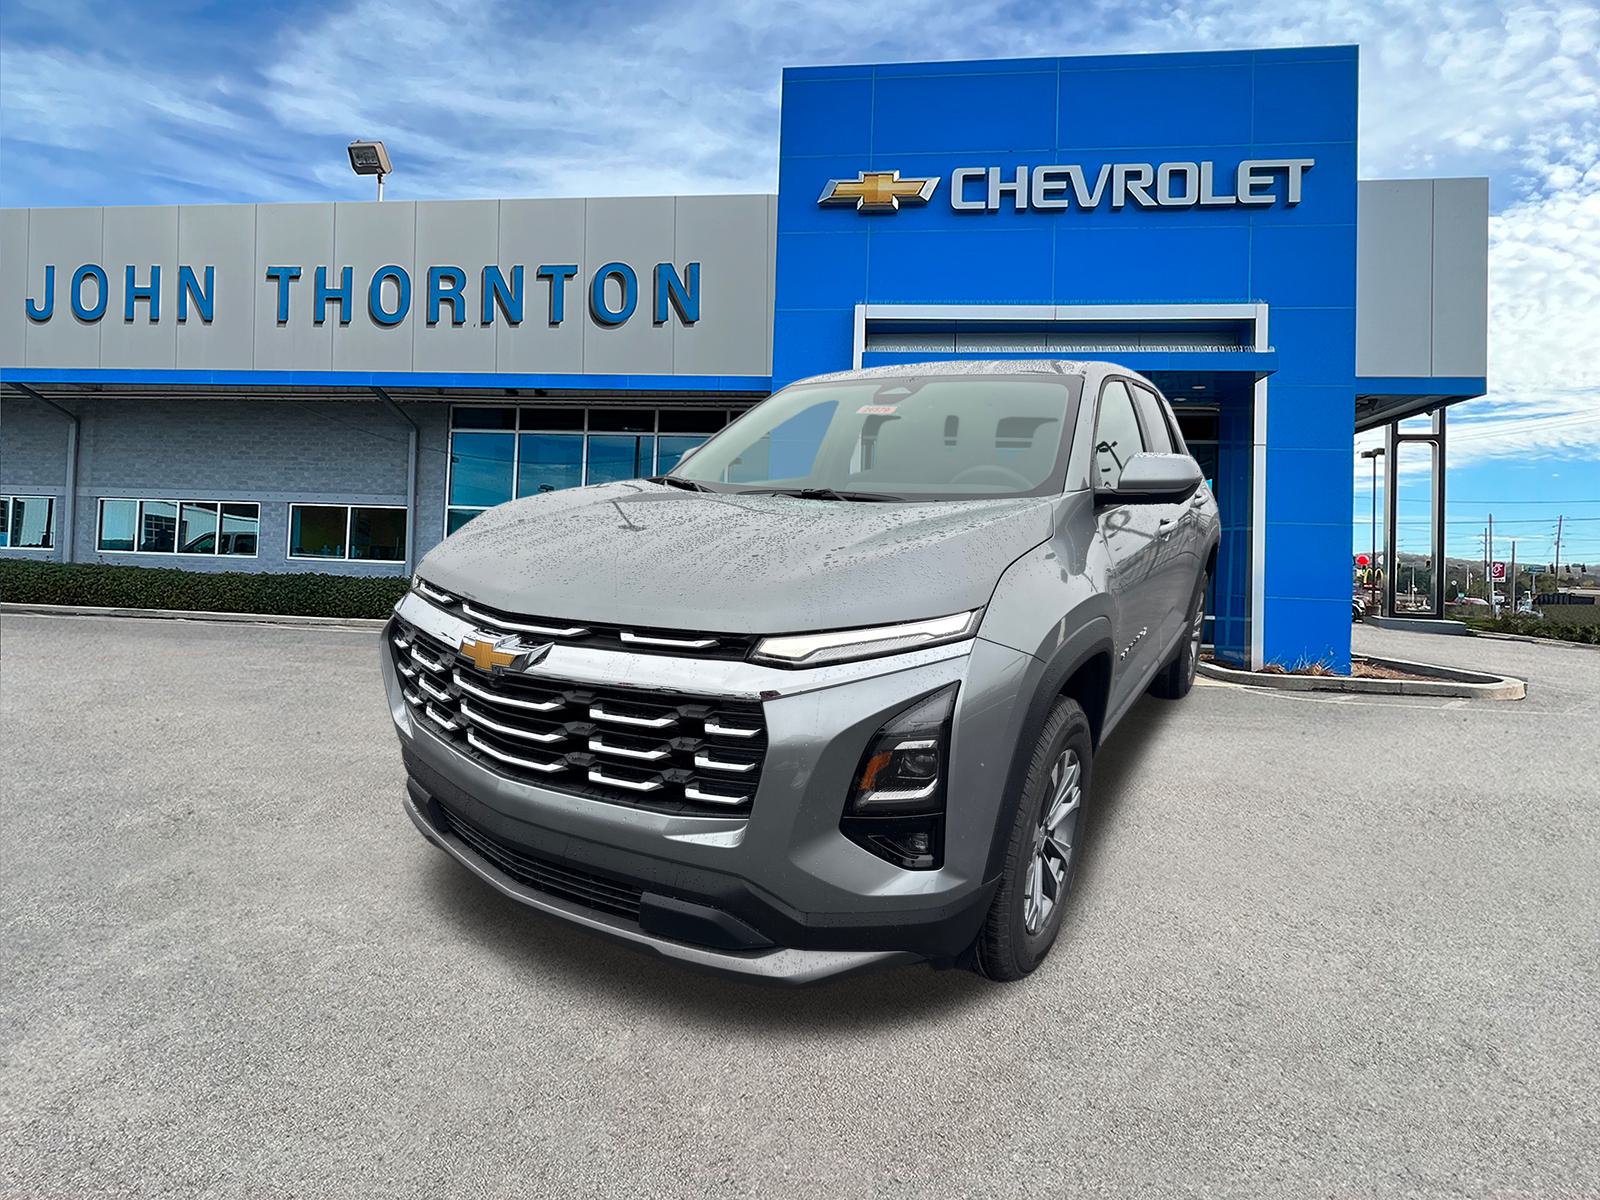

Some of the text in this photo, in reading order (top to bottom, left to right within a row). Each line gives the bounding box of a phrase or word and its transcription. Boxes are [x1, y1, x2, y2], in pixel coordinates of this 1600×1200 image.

[951, 158, 1315, 210] CHEVROLET
[25, 261, 702, 328] JOHN THORNTON
